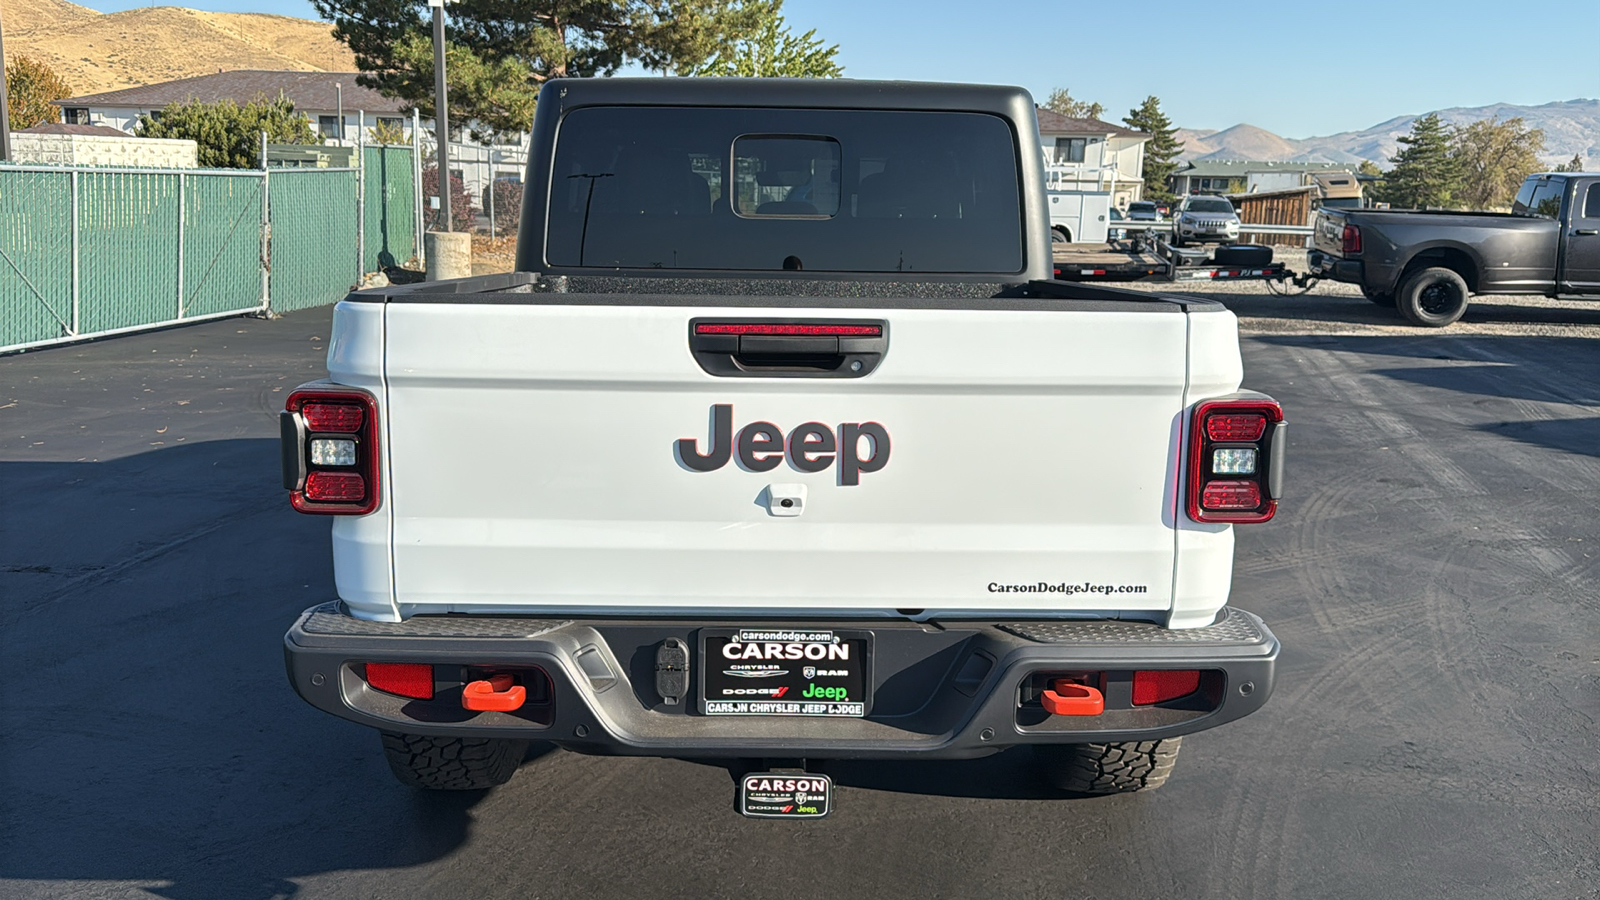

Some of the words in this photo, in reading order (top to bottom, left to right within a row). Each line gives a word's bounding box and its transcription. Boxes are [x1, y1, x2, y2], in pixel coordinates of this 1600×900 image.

[672, 403, 892, 487] Jeep
[987, 582, 1148, 595] CarsonDodgeJeep.com
[742, 631, 831, 642] carsondodge.com
[722, 643, 849, 660] CARSON
[802, 683, 848, 701] Jeep
[749, 703, 800, 713] CHRYSLER
[802, 704, 827, 713] JEEP
[746, 779, 825, 792] CARSON
[797, 806, 817, 814] Jeep
